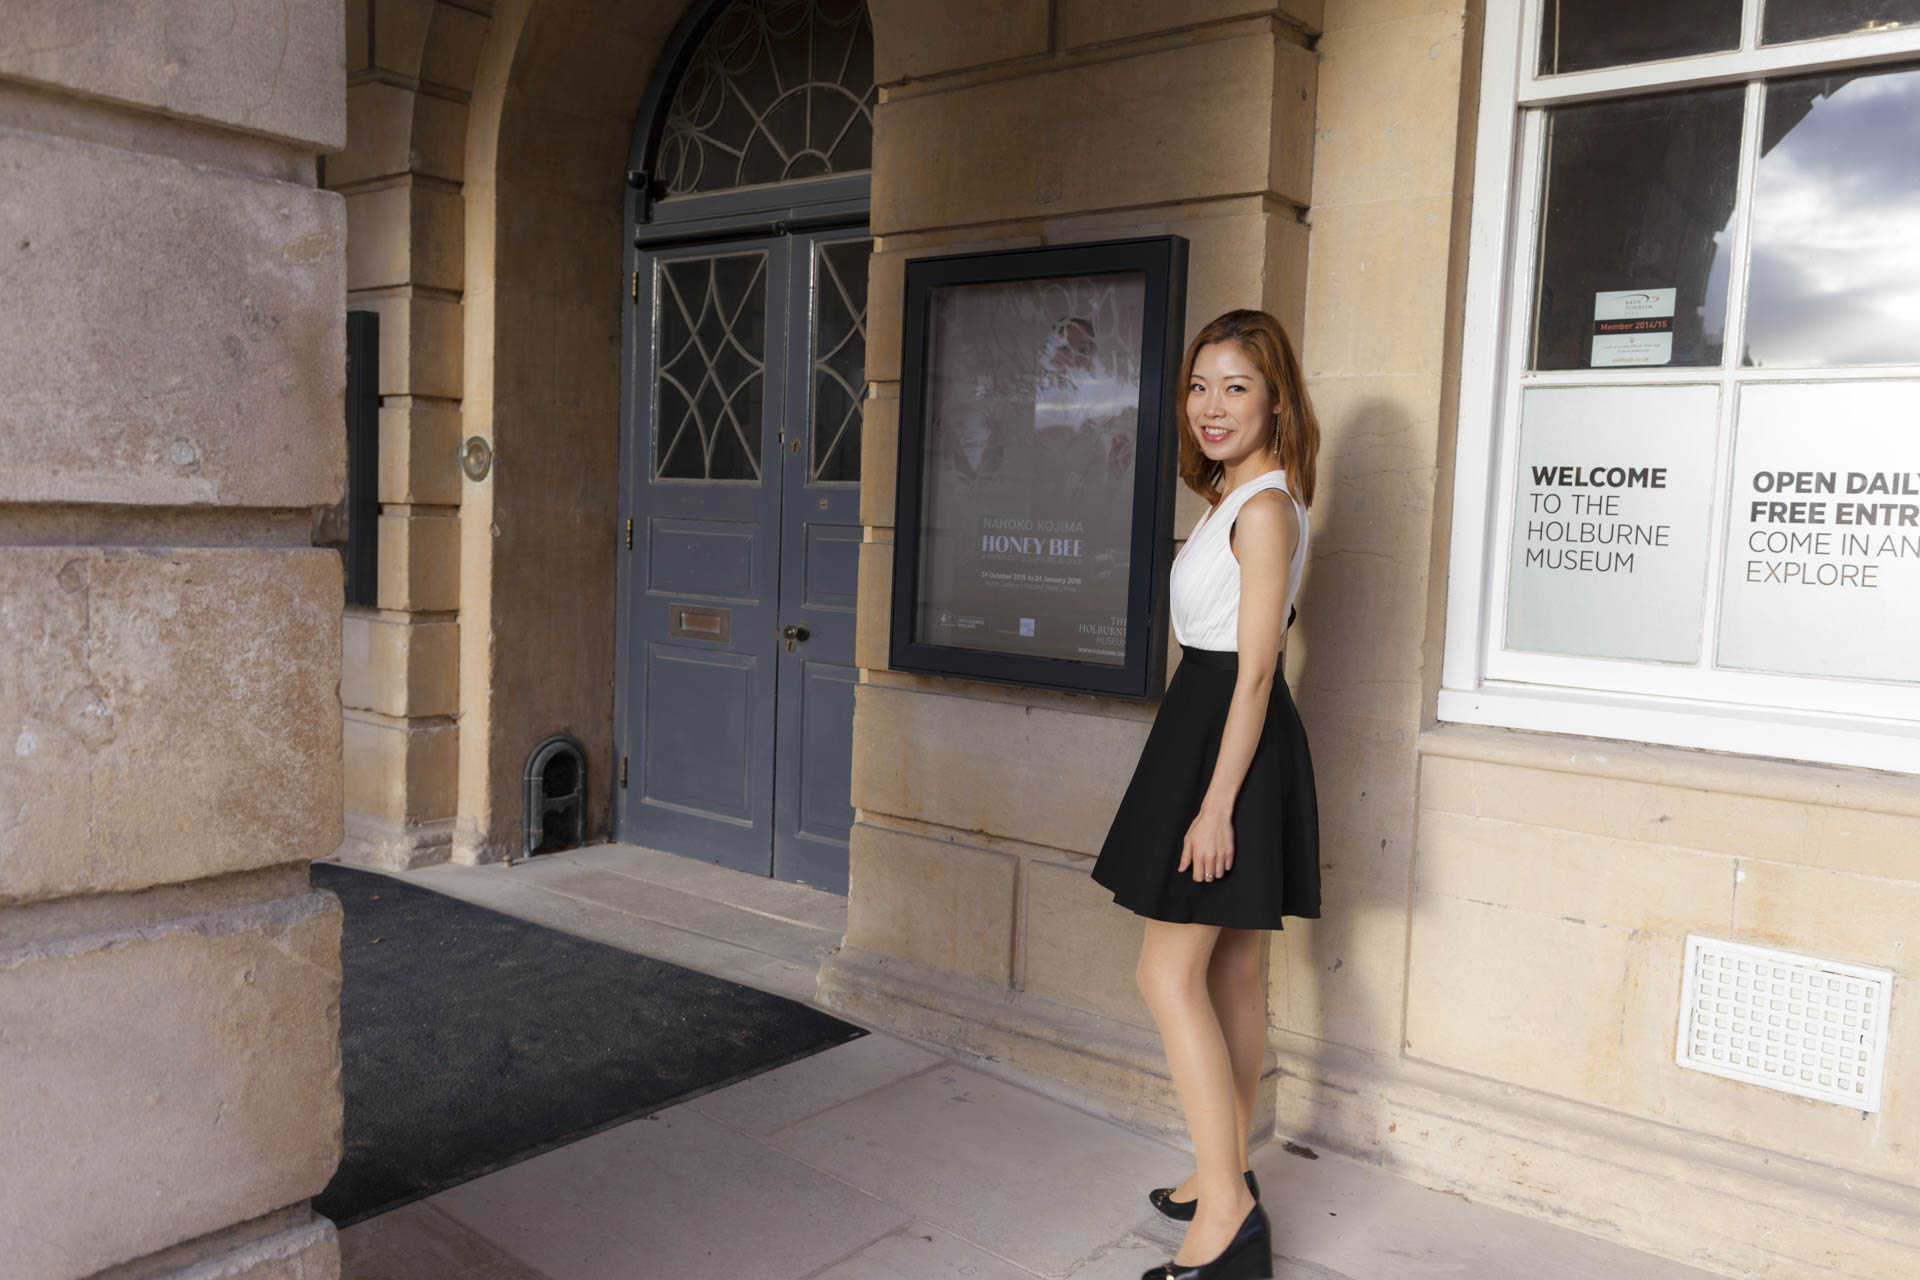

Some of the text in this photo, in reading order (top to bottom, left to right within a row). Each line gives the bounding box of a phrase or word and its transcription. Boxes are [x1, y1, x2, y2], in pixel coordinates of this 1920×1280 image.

[1600, 320, 1668, 331] Member 2014/15
[1531, 465, 1668, 489] WELCOME
[1752, 470, 1920, 496] OPEN DAIL
[1530, 493, 1620, 516] TO THE
[1750, 501, 1827, 525] FREE
[983, 517, 1085, 534] NAHOKO KOJIMA
[1528, 520, 1671, 547] HOLBURNE
[982, 535, 1084, 558] HONEY BEE
[1749, 530, 1832, 555] COME
[1841, 533, 1870, 556] IN
[1526, 547, 1635, 574] MUSEUM
[1042, 575, 1066, 585] January
[1746, 560, 1879, 588] EXPLORE
[1079, 624, 1127, 637] HOLBURNE
[1110, 616, 1128, 626] THE
